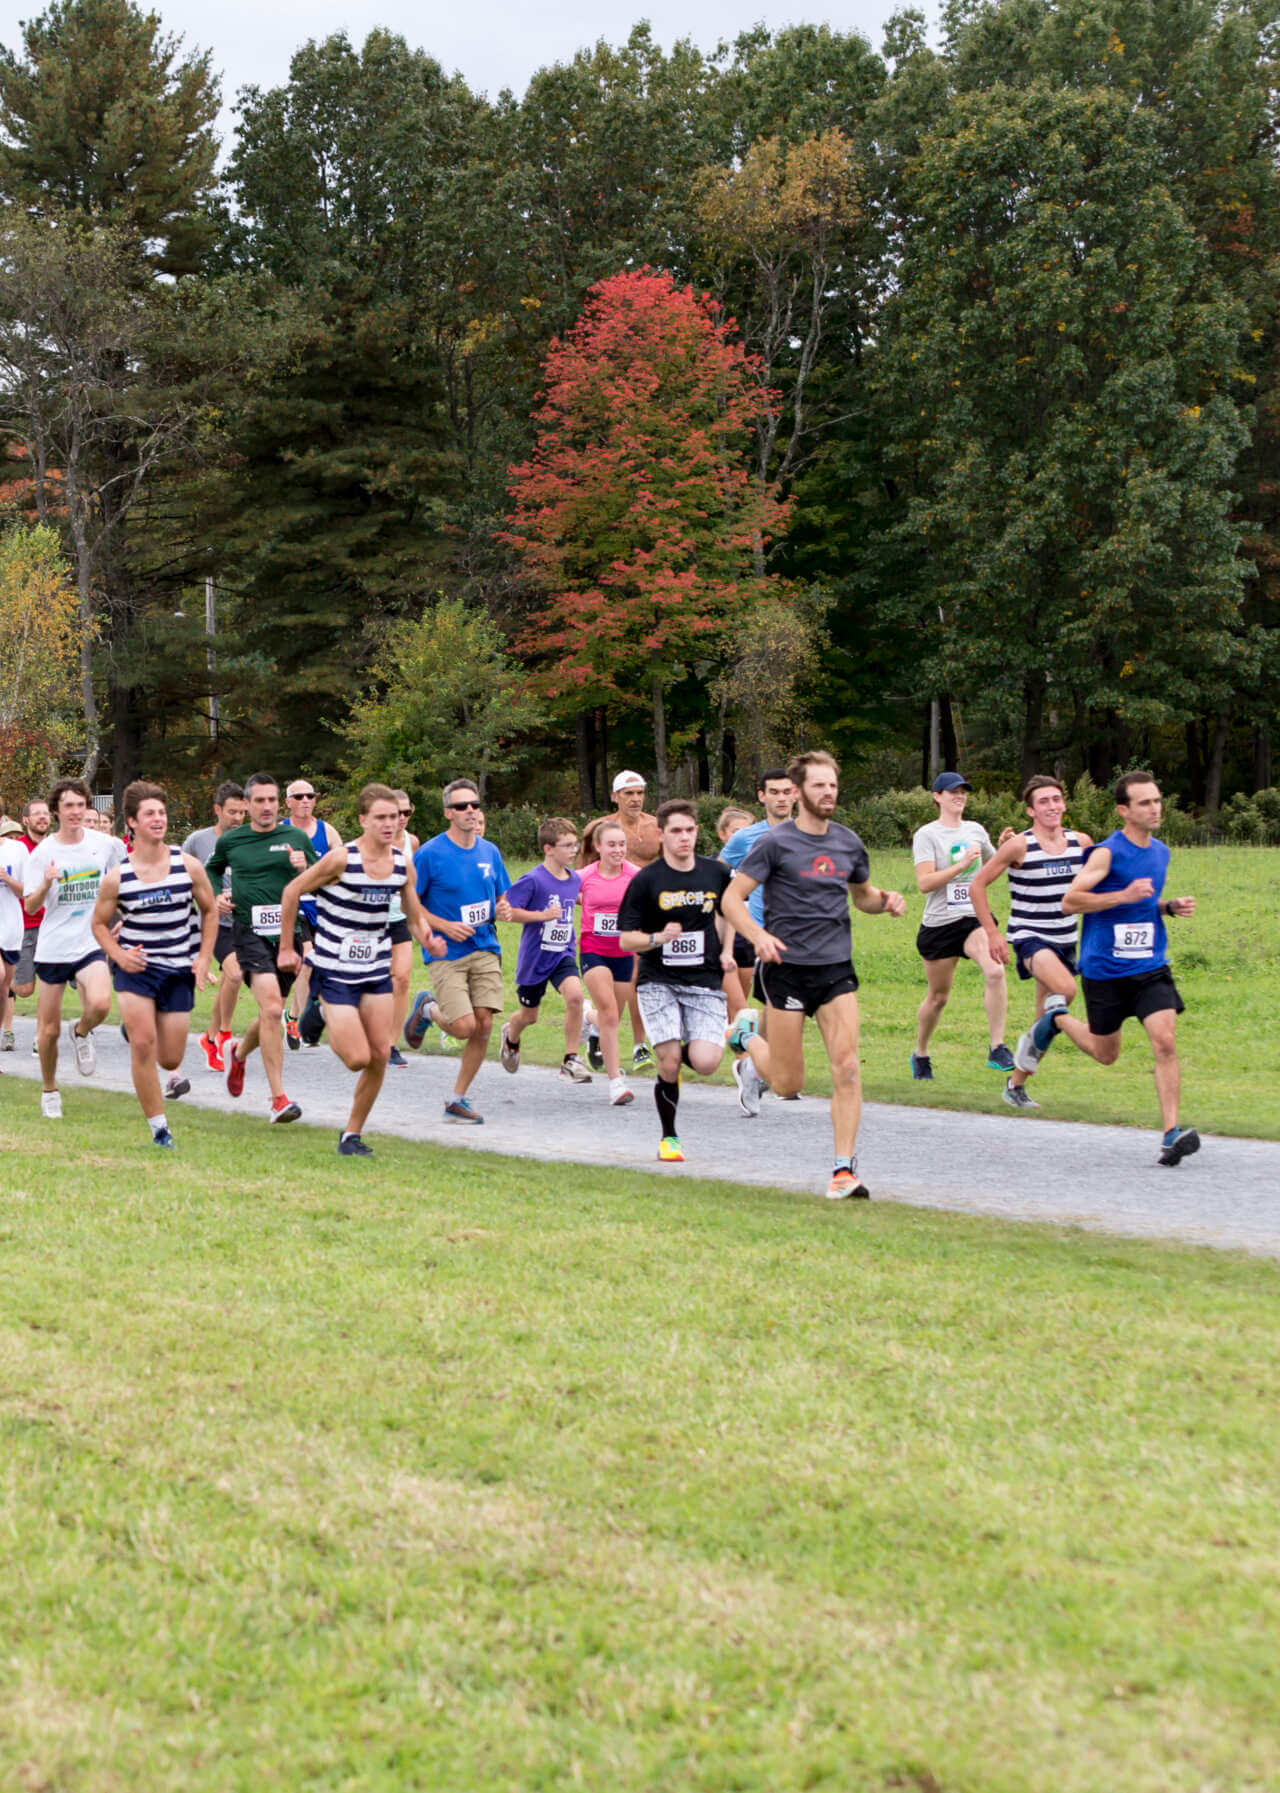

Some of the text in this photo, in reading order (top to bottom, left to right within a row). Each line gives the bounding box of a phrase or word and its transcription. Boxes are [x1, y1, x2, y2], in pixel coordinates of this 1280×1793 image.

[1043, 860, 1073, 876] TOGA
[362, 888, 392, 902] TOGA
[954, 888, 969, 900] 89
[260, 912, 281, 925] 855
[601, 919, 619, 931] 92
[1124, 931, 1147, 945] 872
[348, 945, 372, 959] 650
[671, 939, 696, 953] 868
